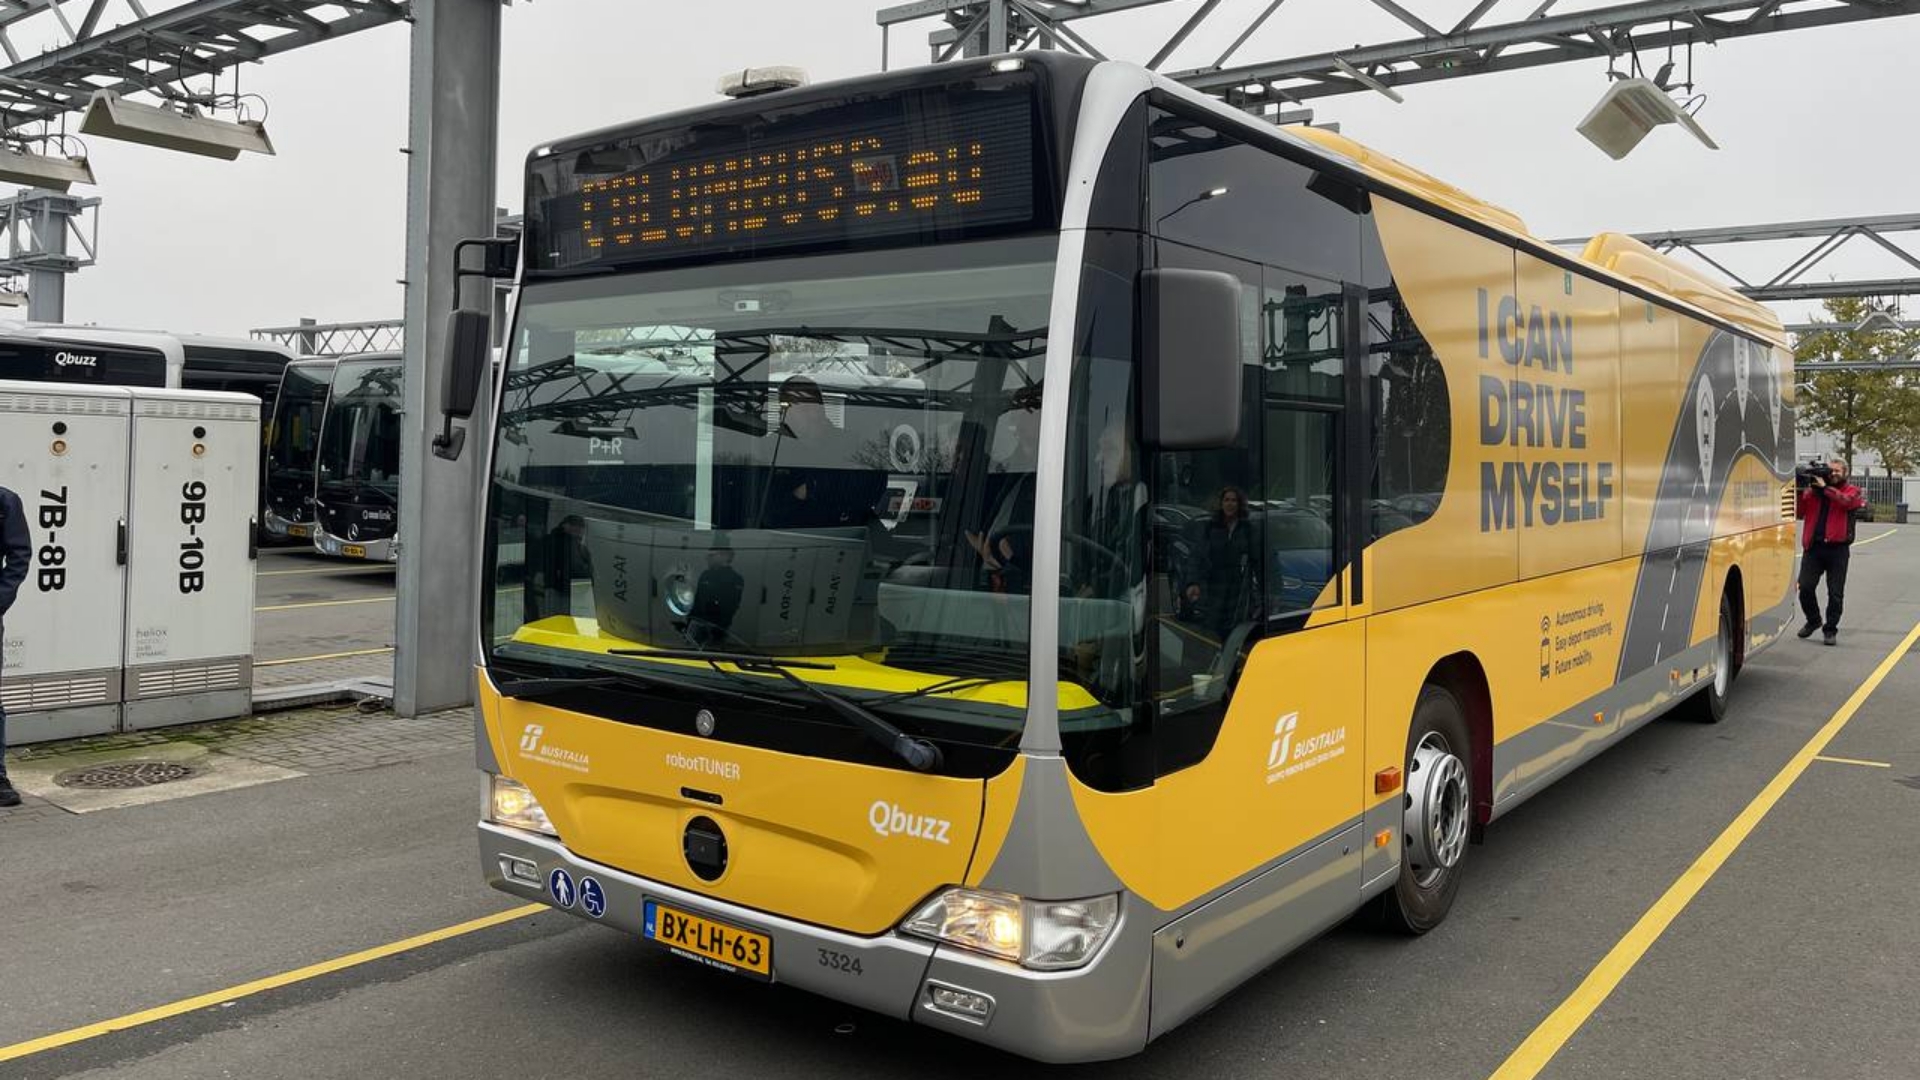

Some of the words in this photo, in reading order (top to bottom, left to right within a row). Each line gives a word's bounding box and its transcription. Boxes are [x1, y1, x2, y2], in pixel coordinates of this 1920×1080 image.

[1477, 287, 1488, 359] I
[1497, 295, 1573, 374] CAN
[55, 352, 97, 366] Qbuzz
[1479, 374, 1586, 449] DRIVE
[589, 438, 622, 455] P+R
[1479, 461, 1612, 532] MYSELF
[38, 485, 68, 592] 7B-8B
[179, 480, 207, 594] 9B-10B
[540, 744, 589, 764] BUSITALIA
[665, 751, 740, 781] robotTUNER
[1294, 726, 1345, 760] BUSITALIA
[868, 800, 951, 846] Qbuzz
[662, 911, 761, 966] BX-LH-63
[817, 948, 863, 977] 3324
